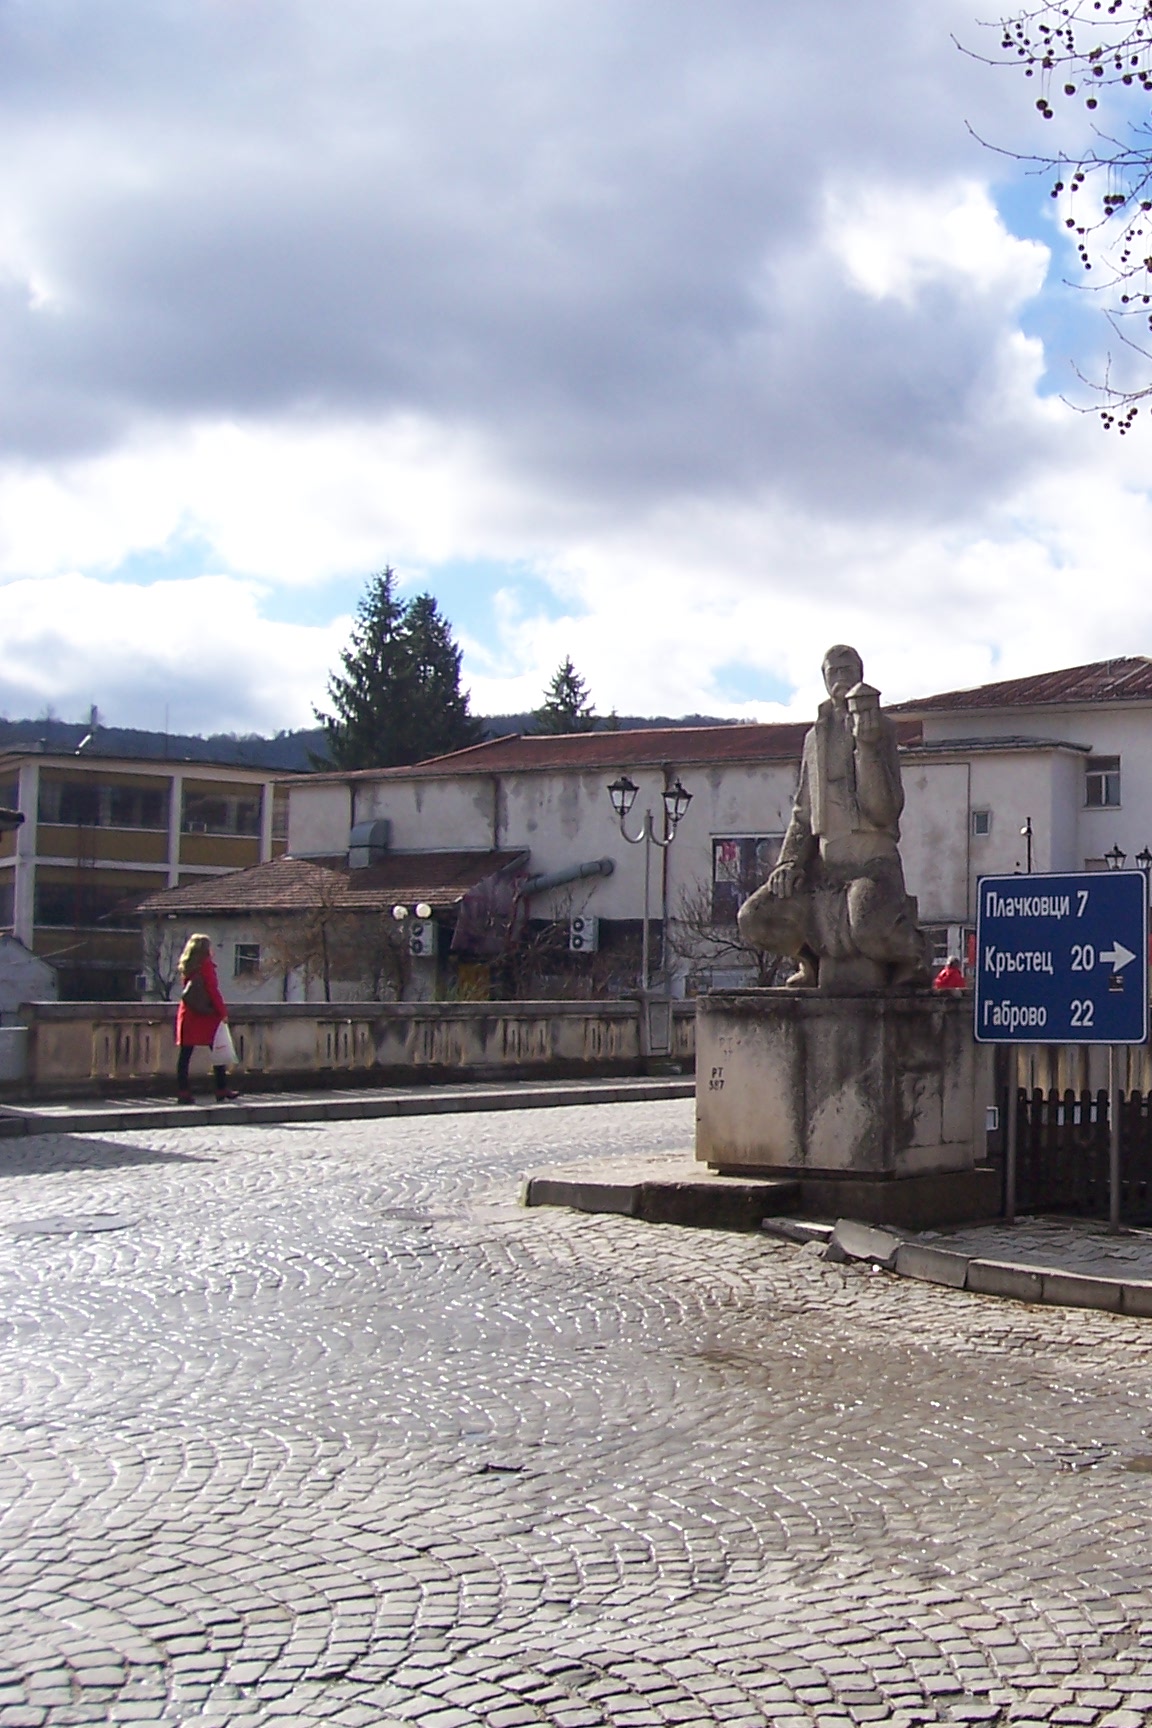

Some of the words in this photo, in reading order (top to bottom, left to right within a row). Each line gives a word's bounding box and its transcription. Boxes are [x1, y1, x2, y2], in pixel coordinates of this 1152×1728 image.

[986, 891, 1069, 919] Плачковци
[1077, 890, 1088, 917] 7
[985, 946, 1053, 978] Кръстец
[1071, 945, 1094, 970] 20
[983, 1000, 1046, 1032] Габрово
[1070, 1000, 1093, 1026] 22
